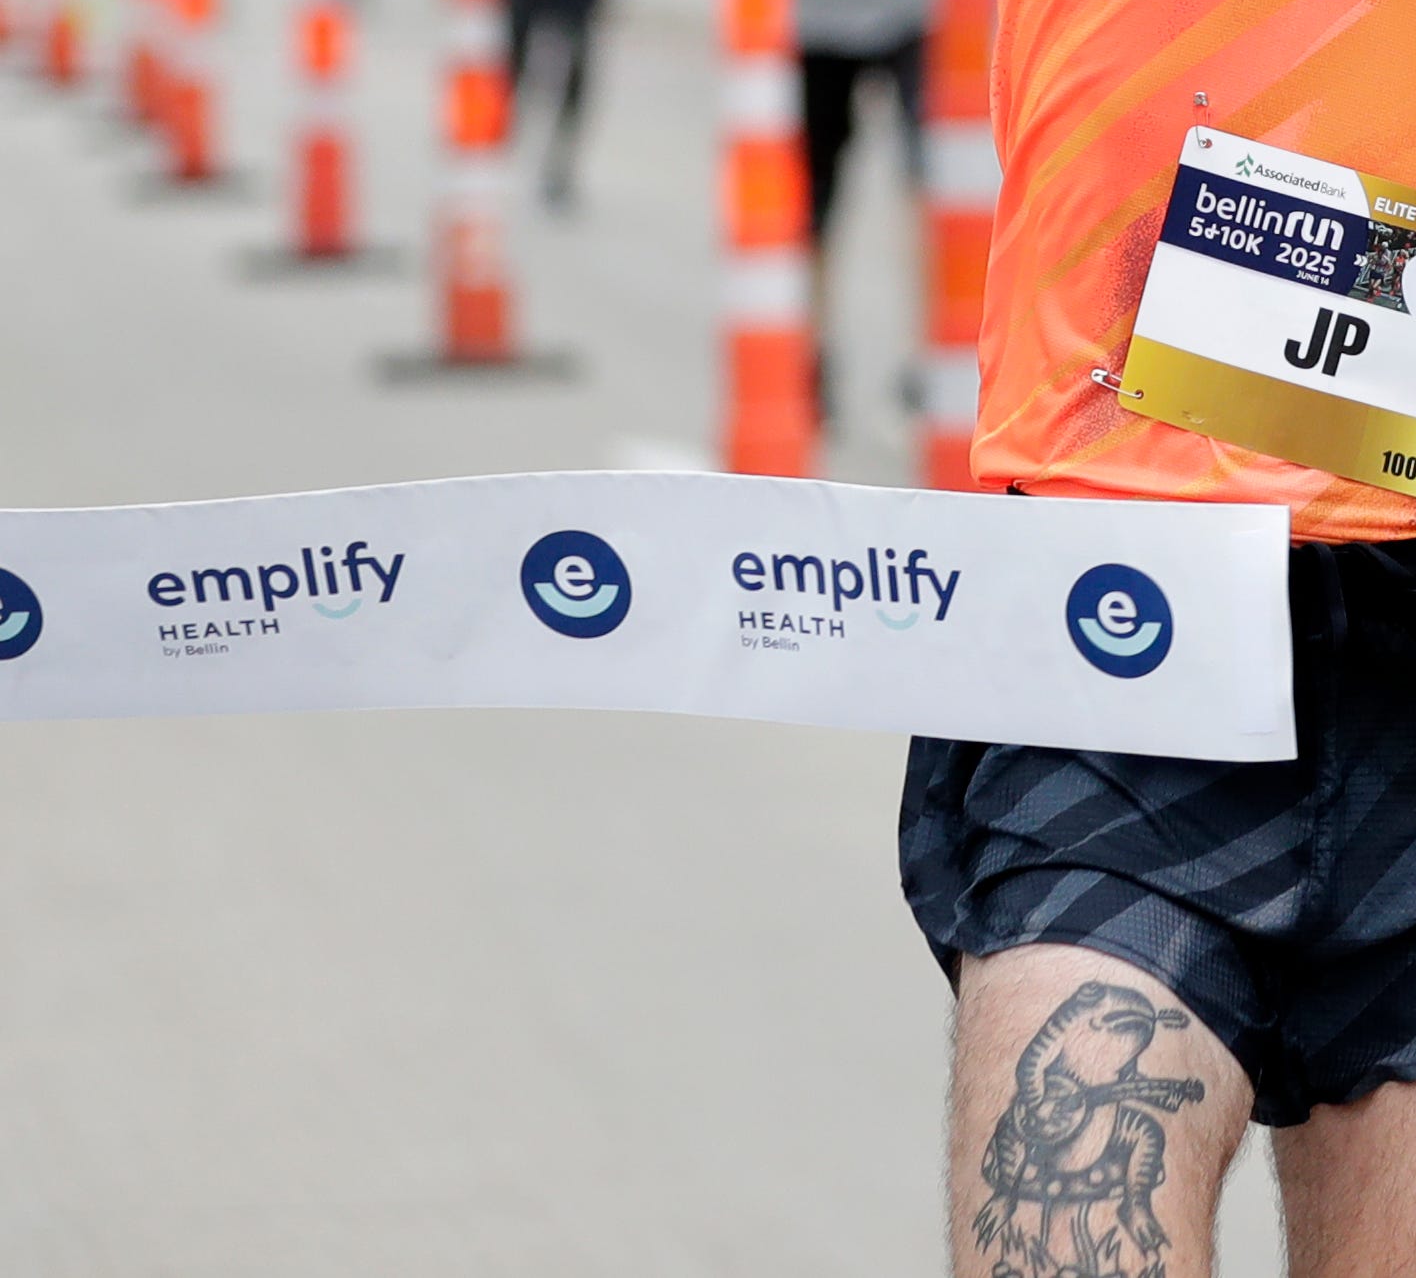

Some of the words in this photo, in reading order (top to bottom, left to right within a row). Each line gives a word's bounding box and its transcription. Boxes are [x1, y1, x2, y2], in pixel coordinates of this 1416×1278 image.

[1275, 242, 1337, 276] 2025
[1295, 270, 1319, 285] JUNE
[1319, 276, 1331, 287] 14
[1283, 307, 1371, 377] JP
[147, 539, 406, 612] emplify
[552, 554, 598, 597] e
[731, 547, 962, 621] emplify
[738, 609, 846, 639] HEALTH
[1096, 590, 1138, 633] e
[158, 618, 282, 642] HEALTH
[741, 633, 760, 652] by
[761, 634, 801, 653] Bellin
[162, 643, 182, 659] by
[184, 641, 230, 658] Bellin
